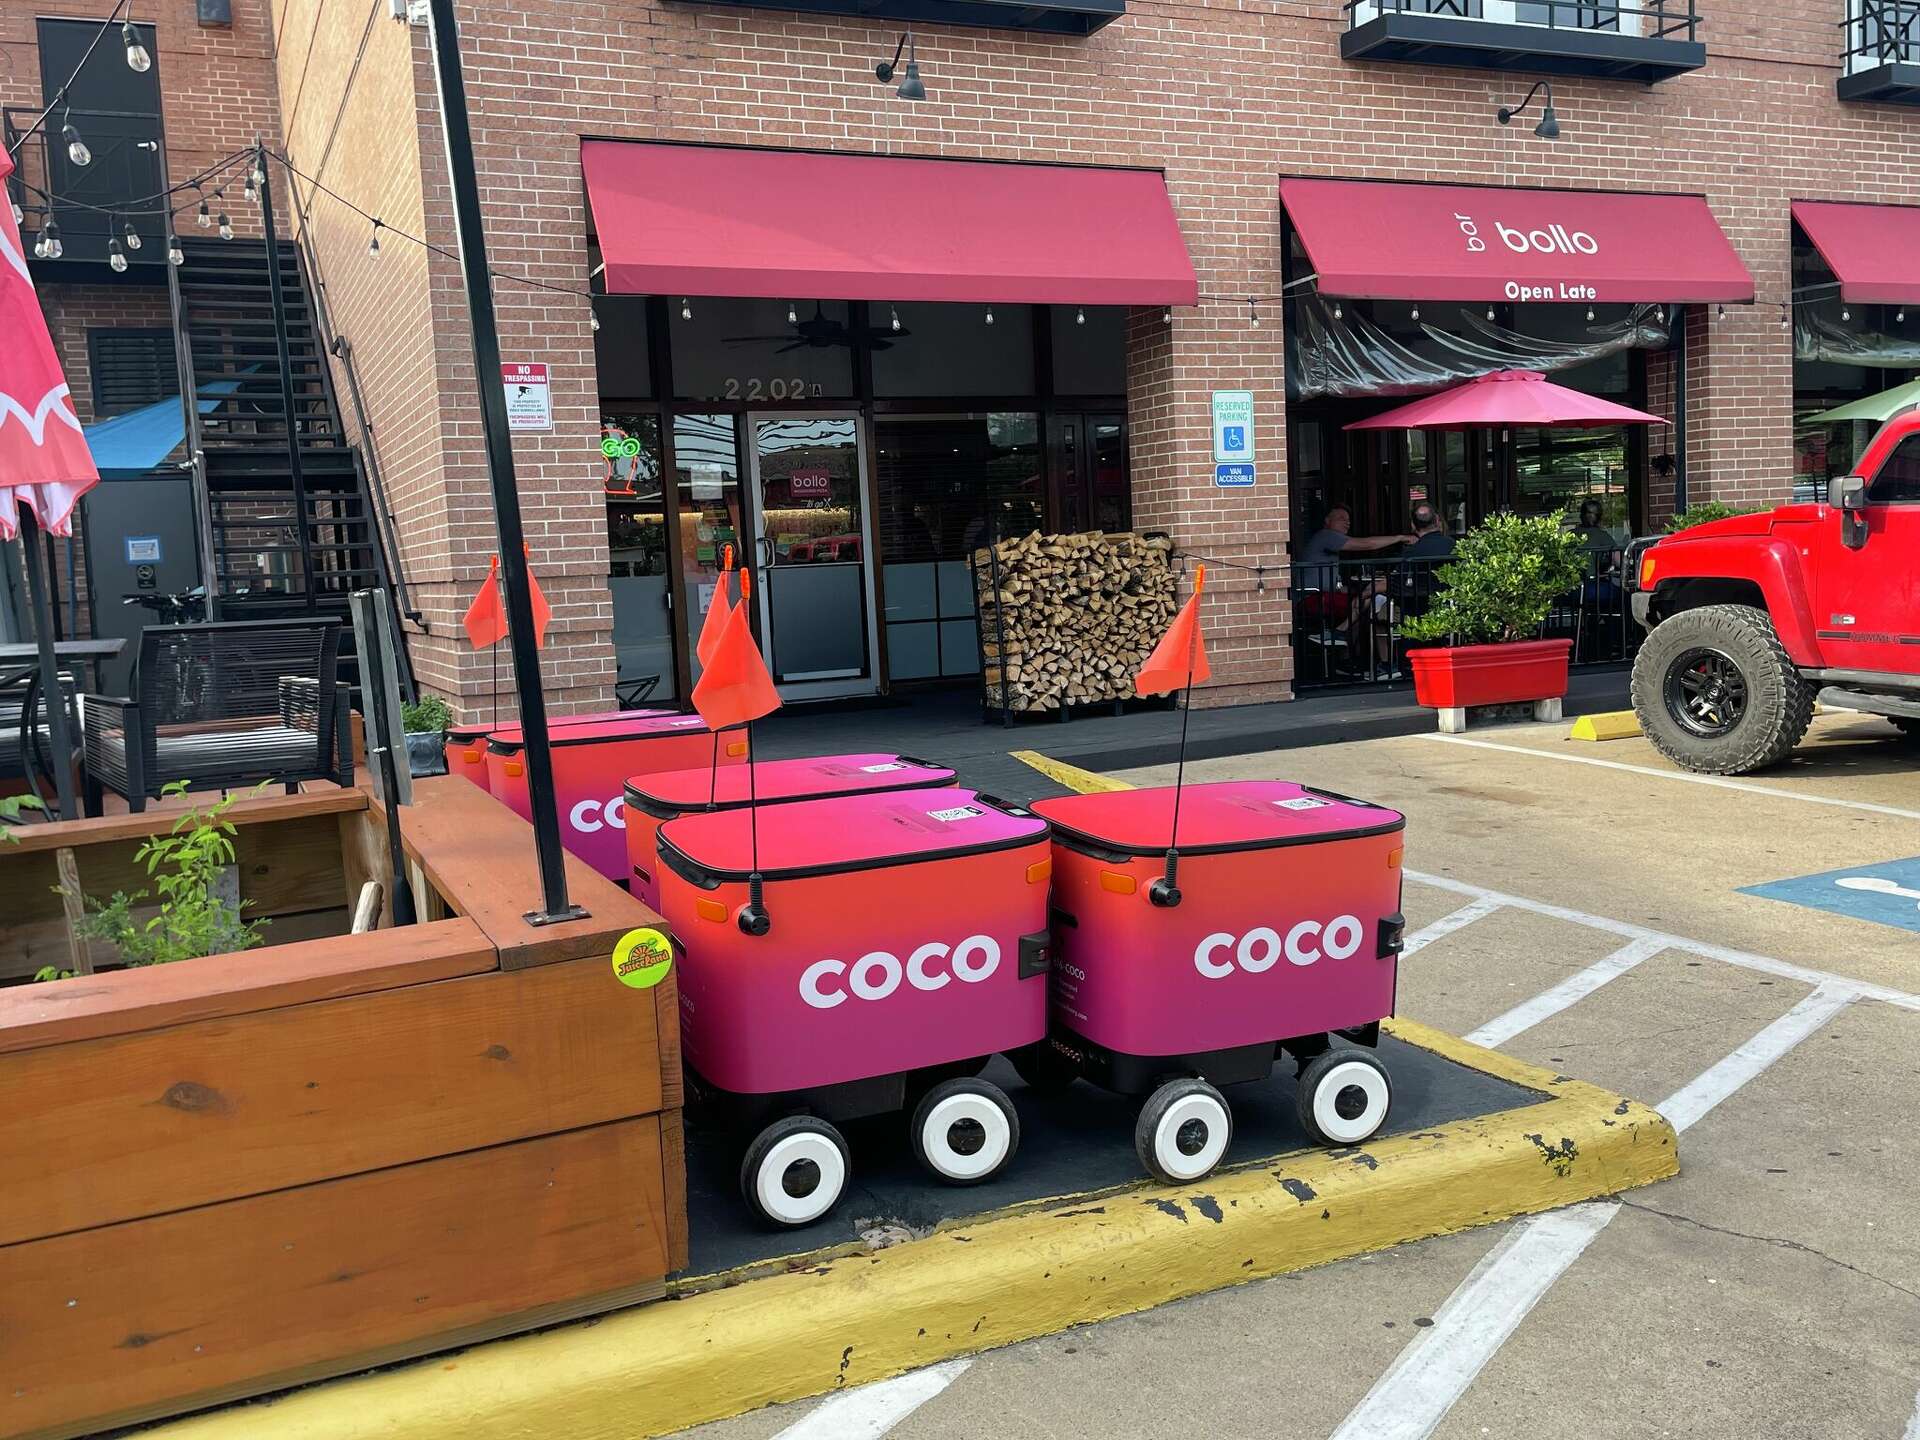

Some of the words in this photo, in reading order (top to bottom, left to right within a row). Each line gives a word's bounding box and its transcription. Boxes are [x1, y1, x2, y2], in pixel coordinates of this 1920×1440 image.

[1454, 212, 1486, 252] bar
[1494, 222, 1599, 255] bollo
[1504, 281, 1554, 302] Open
[1559, 282, 1597, 299] Late
[504, 374, 546, 383] TRESPASSING
[517, 365, 531, 375] NO
[724, 378, 806, 401] 2202
[1216, 401, 1250, 411] RESERVED
[1220, 412, 1248, 421] PARKING
[601, 438, 641, 457] GO
[1218, 475, 1253, 483] ACCESSIBLE
[1229, 467, 1242, 475] VAN
[793, 475, 828, 487] bollo
[569, 796, 626, 833] CO
[1194, 914, 1364, 979] COCO
[799, 934, 1001, 1009] COCO
